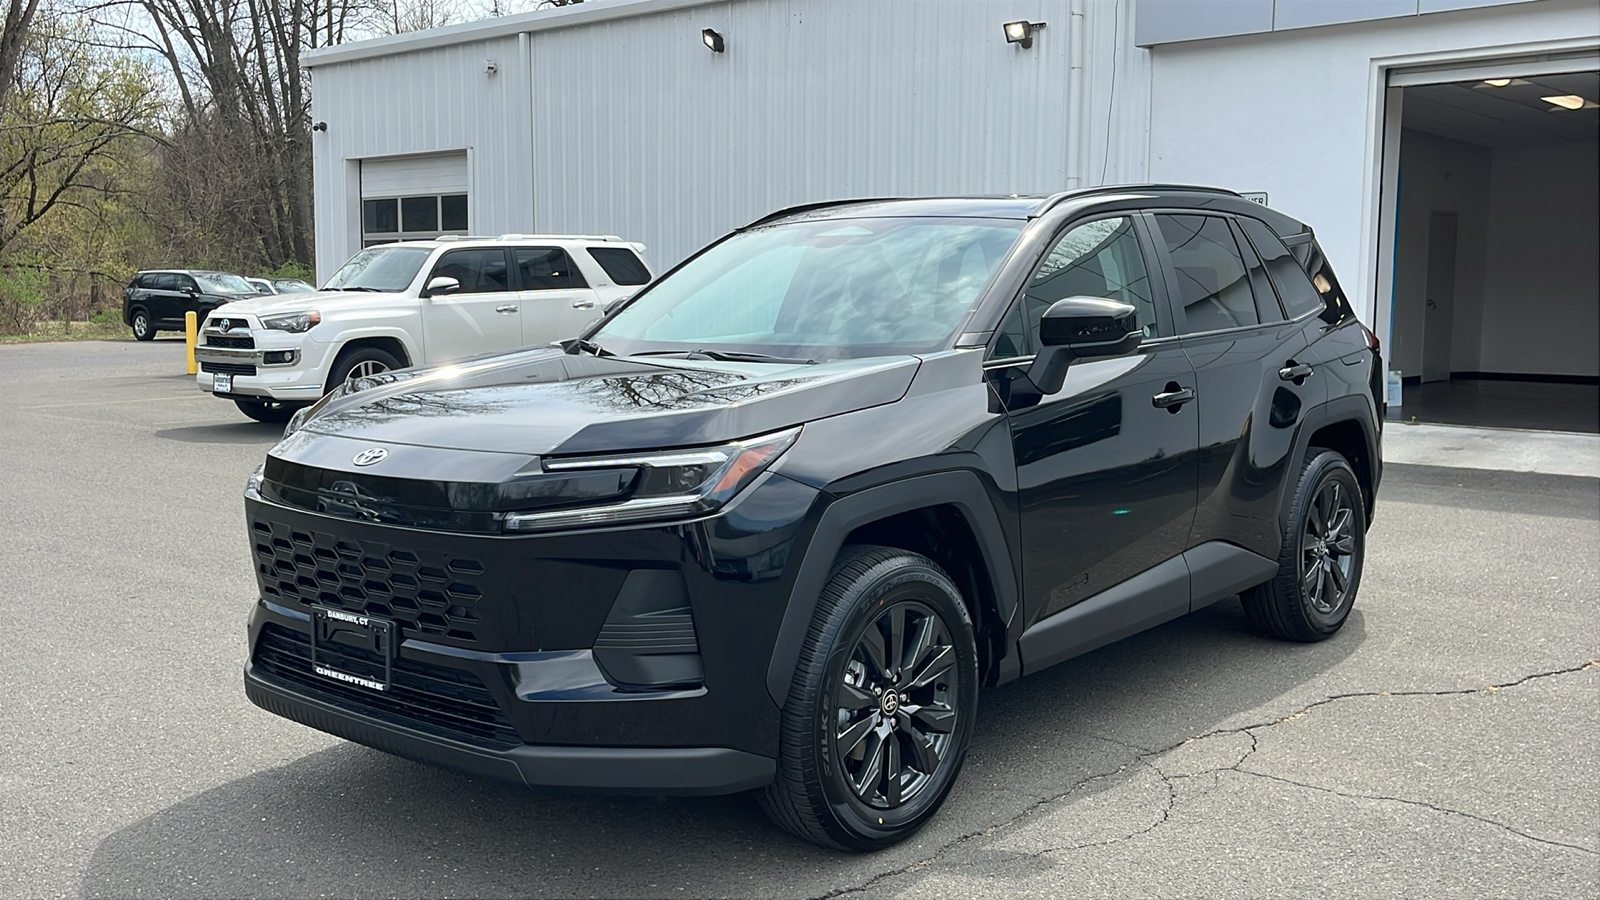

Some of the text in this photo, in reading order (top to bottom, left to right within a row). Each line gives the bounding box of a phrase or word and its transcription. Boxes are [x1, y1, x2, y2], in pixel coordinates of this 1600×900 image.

[327, 610, 369, 625] DANBURY, CT
[315, 667, 384, 691] GREENTREE
